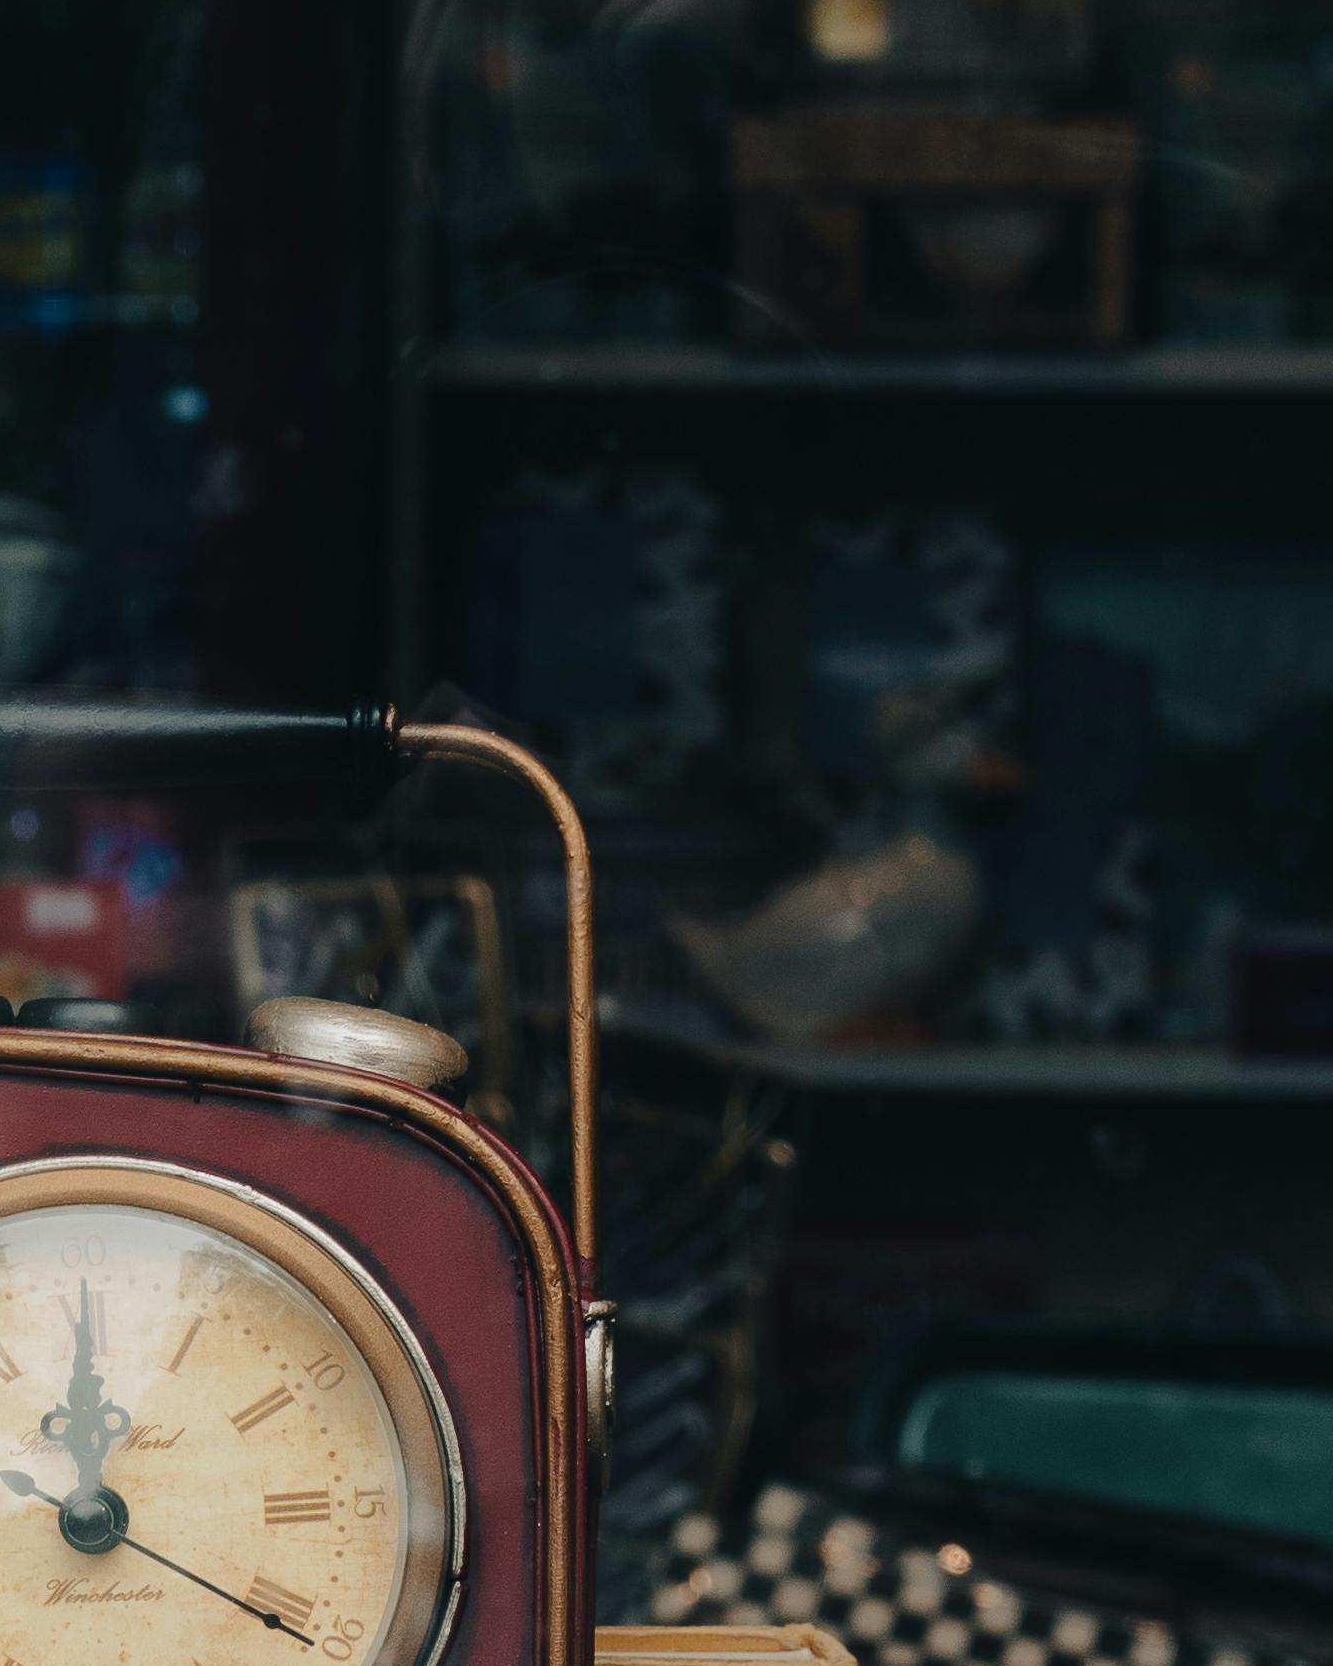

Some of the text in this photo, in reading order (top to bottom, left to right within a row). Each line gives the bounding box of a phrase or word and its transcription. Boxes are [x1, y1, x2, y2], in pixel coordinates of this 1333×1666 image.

[61, 1235, 106, 1268] 60
[159, 1310, 212, 1378] I
[301, 1346, 346, 1391] 10
[227, 1381, 299, 1439] II
[118, 1424, 185, 1452] Ward
[263, 1488, 331, 1527] III
[353, 1484, 386, 1520] 15
[44, 1577, 166, 1606] Winchester
[322, 1614, 364, 1661] 20
